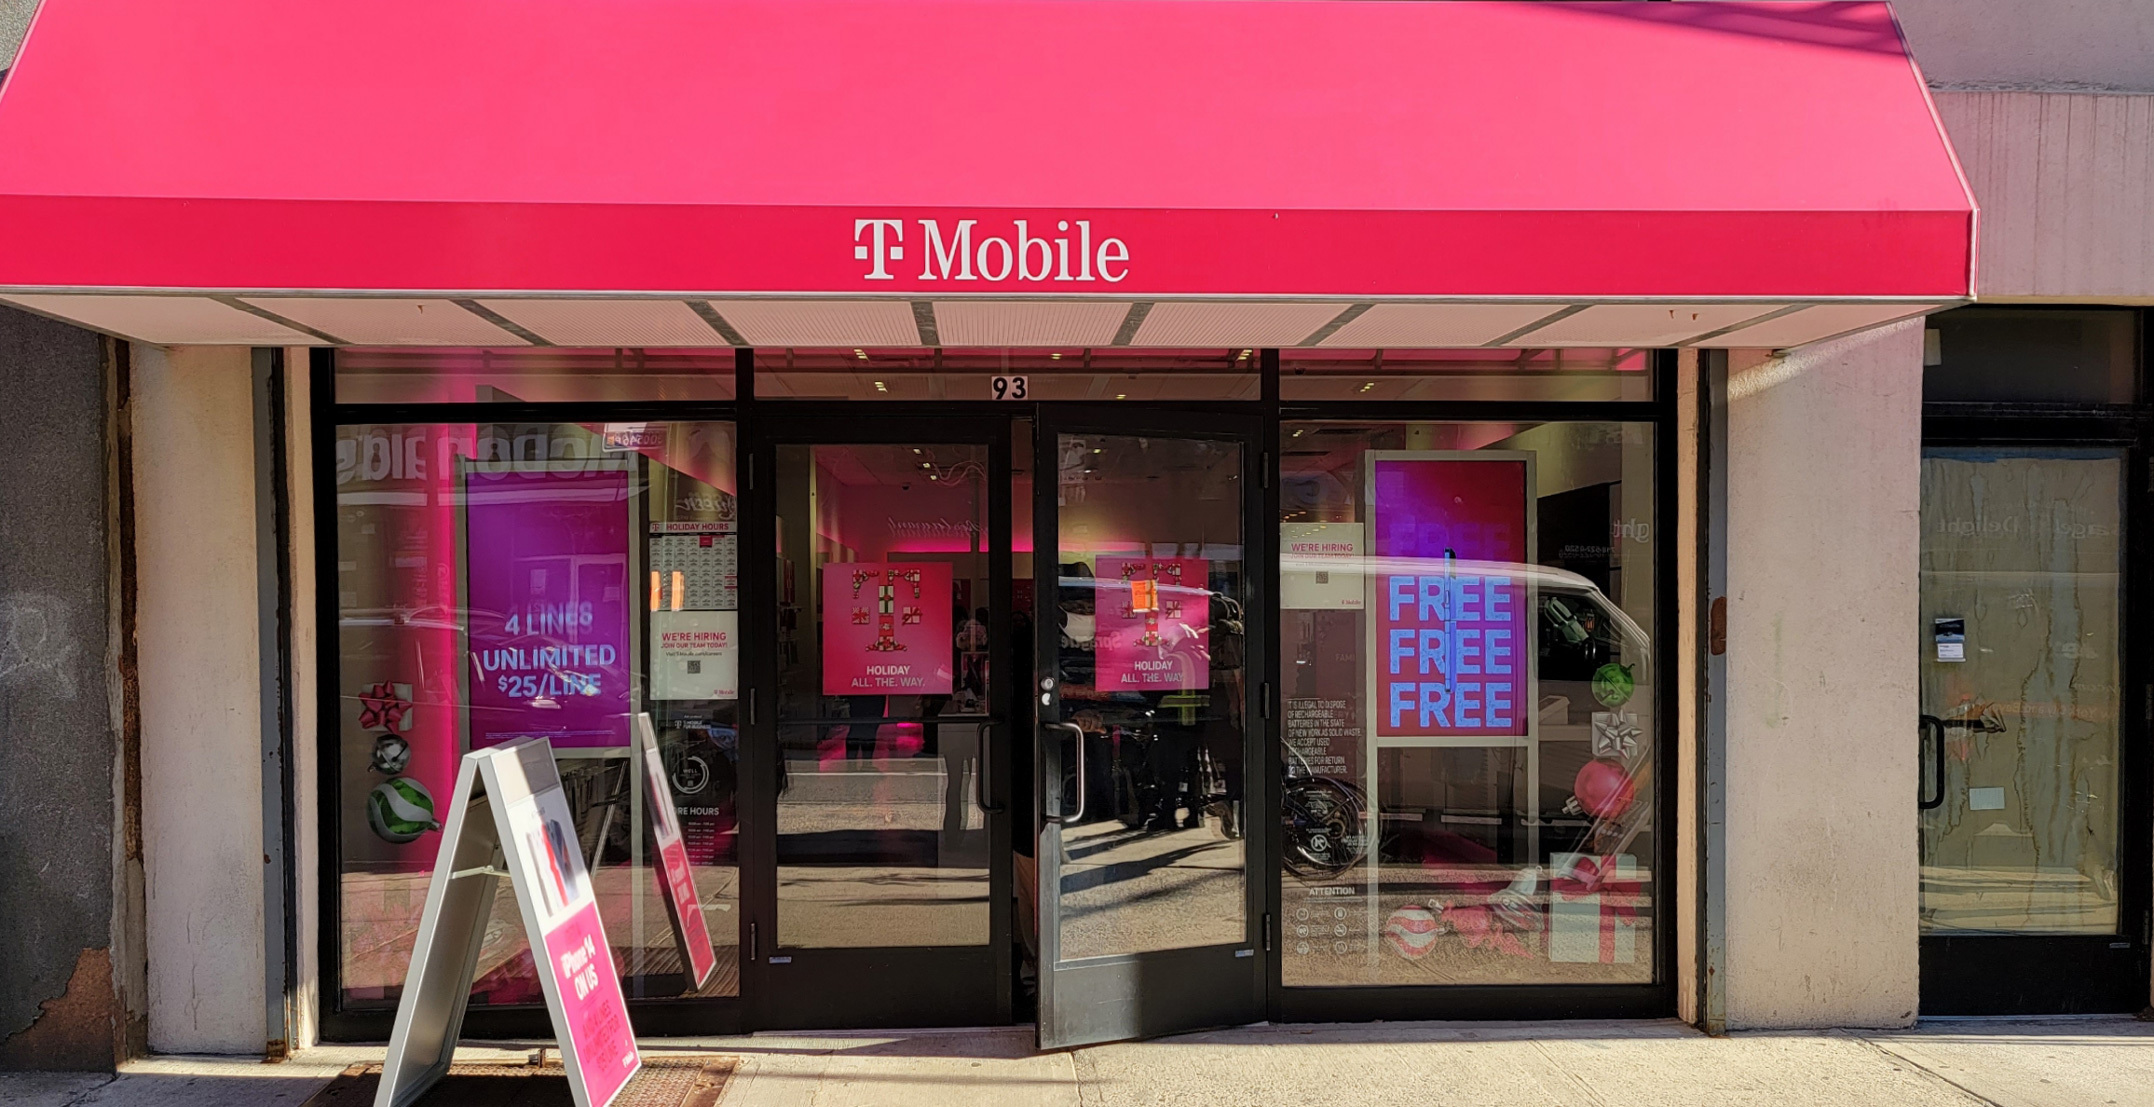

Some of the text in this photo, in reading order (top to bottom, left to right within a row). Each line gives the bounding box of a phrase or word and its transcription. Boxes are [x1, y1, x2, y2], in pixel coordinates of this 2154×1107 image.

[854, 219, 1130, 283] T Mobile
[993, 376, 1026, 400] 93
[666, 523, 700, 531] HOLIDAY
[701, 523, 729, 531] HOURS
[1291, 543, 1354, 552] WE'RE HIRING
[1389, 575, 1511, 622] FREE
[504, 610, 521, 636] 4
[661, 632, 727, 641] WE'RE HIRING
[1389, 628, 1512, 675] FREE
[482, 644, 617, 671] UNLIMITED
[866, 665, 911, 676] HOLIDAY
[1134, 660, 1174, 671] HOLIDAY
[497, 672, 602, 698] $25/LINE
[851, 677, 926, 688] ALL. THE. WAY.
[1325, 700, 1346, 709] DISPOSE
[1390, 681, 1512, 728] FREE
[1288, 710, 1295, 718] OF
[1295, 710, 1333, 718] RECHARGEABLE
[1288, 719, 1345, 728] BATTERIES IN THE STATE
[1288, 728, 1295, 737] OF
[1295, 728, 1307, 737] NEW
[1308, 728, 1320, 737] YORK
[1320, 728, 1329, 736] AS
[1329, 728, 1343, 736] SOLID
[1296, 738, 1316, 746] ACCEPT
[1316, 738, 1330, 746] USED
[1314, 756, 1325, 765] FOR
[1325, 756, 1345, 765] RETURN
[689, 807, 720, 816] HOURS
[1309, 887, 1355, 896] ATTENTION
[560, 945, 588, 979] iPhone
[583, 933, 596, 959] 14
[574, 973, 590, 1000] ON
[585, 963, 599, 991] US
